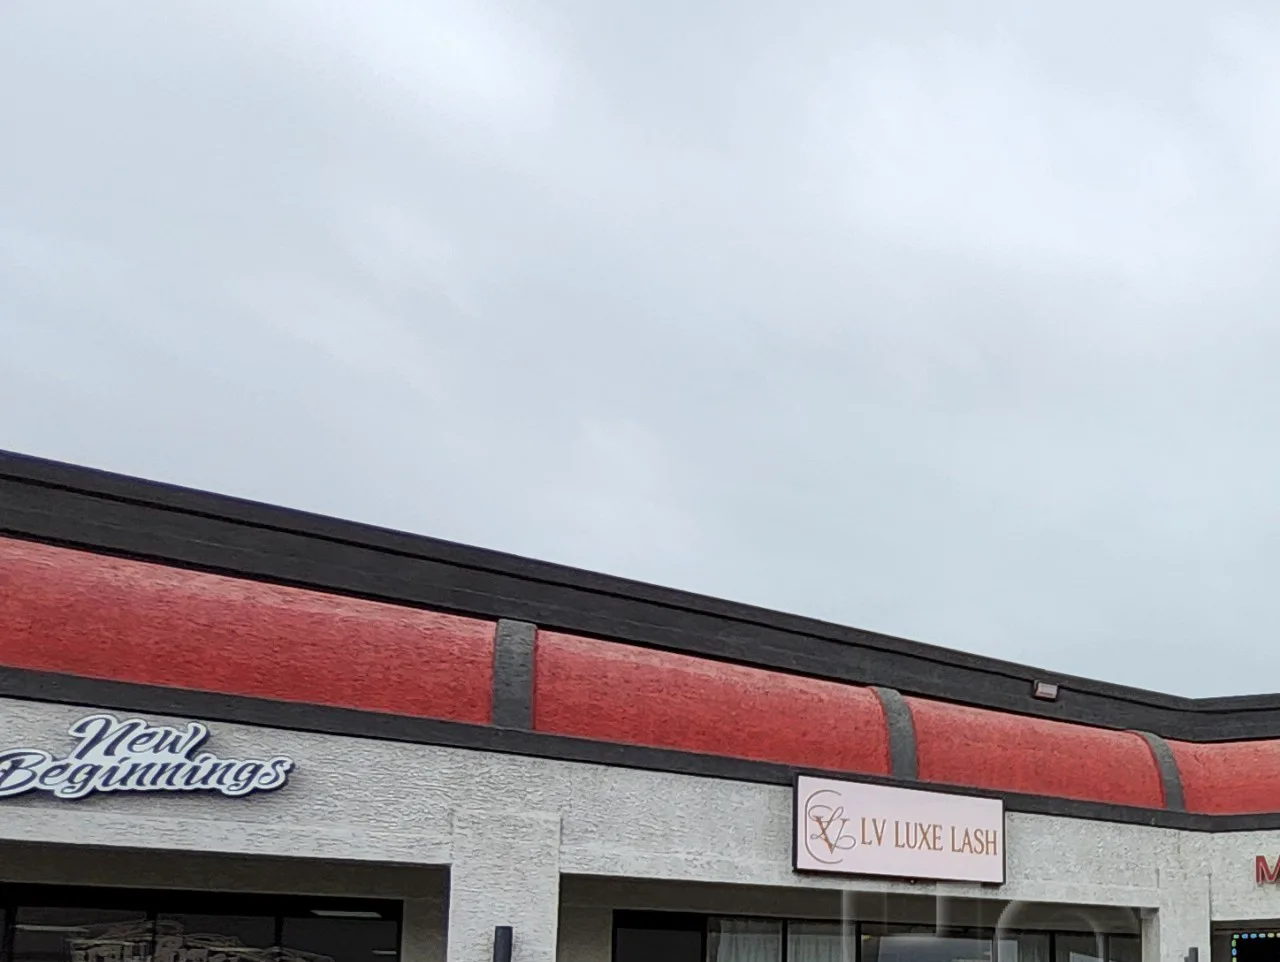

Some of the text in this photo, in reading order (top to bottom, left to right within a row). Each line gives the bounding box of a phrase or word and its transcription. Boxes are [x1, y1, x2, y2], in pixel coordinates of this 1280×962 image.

[69, 714, 209, 761] New
[0, 750, 293, 797] Beginnings
[860, 816, 998, 855] LV LUXE LASH
